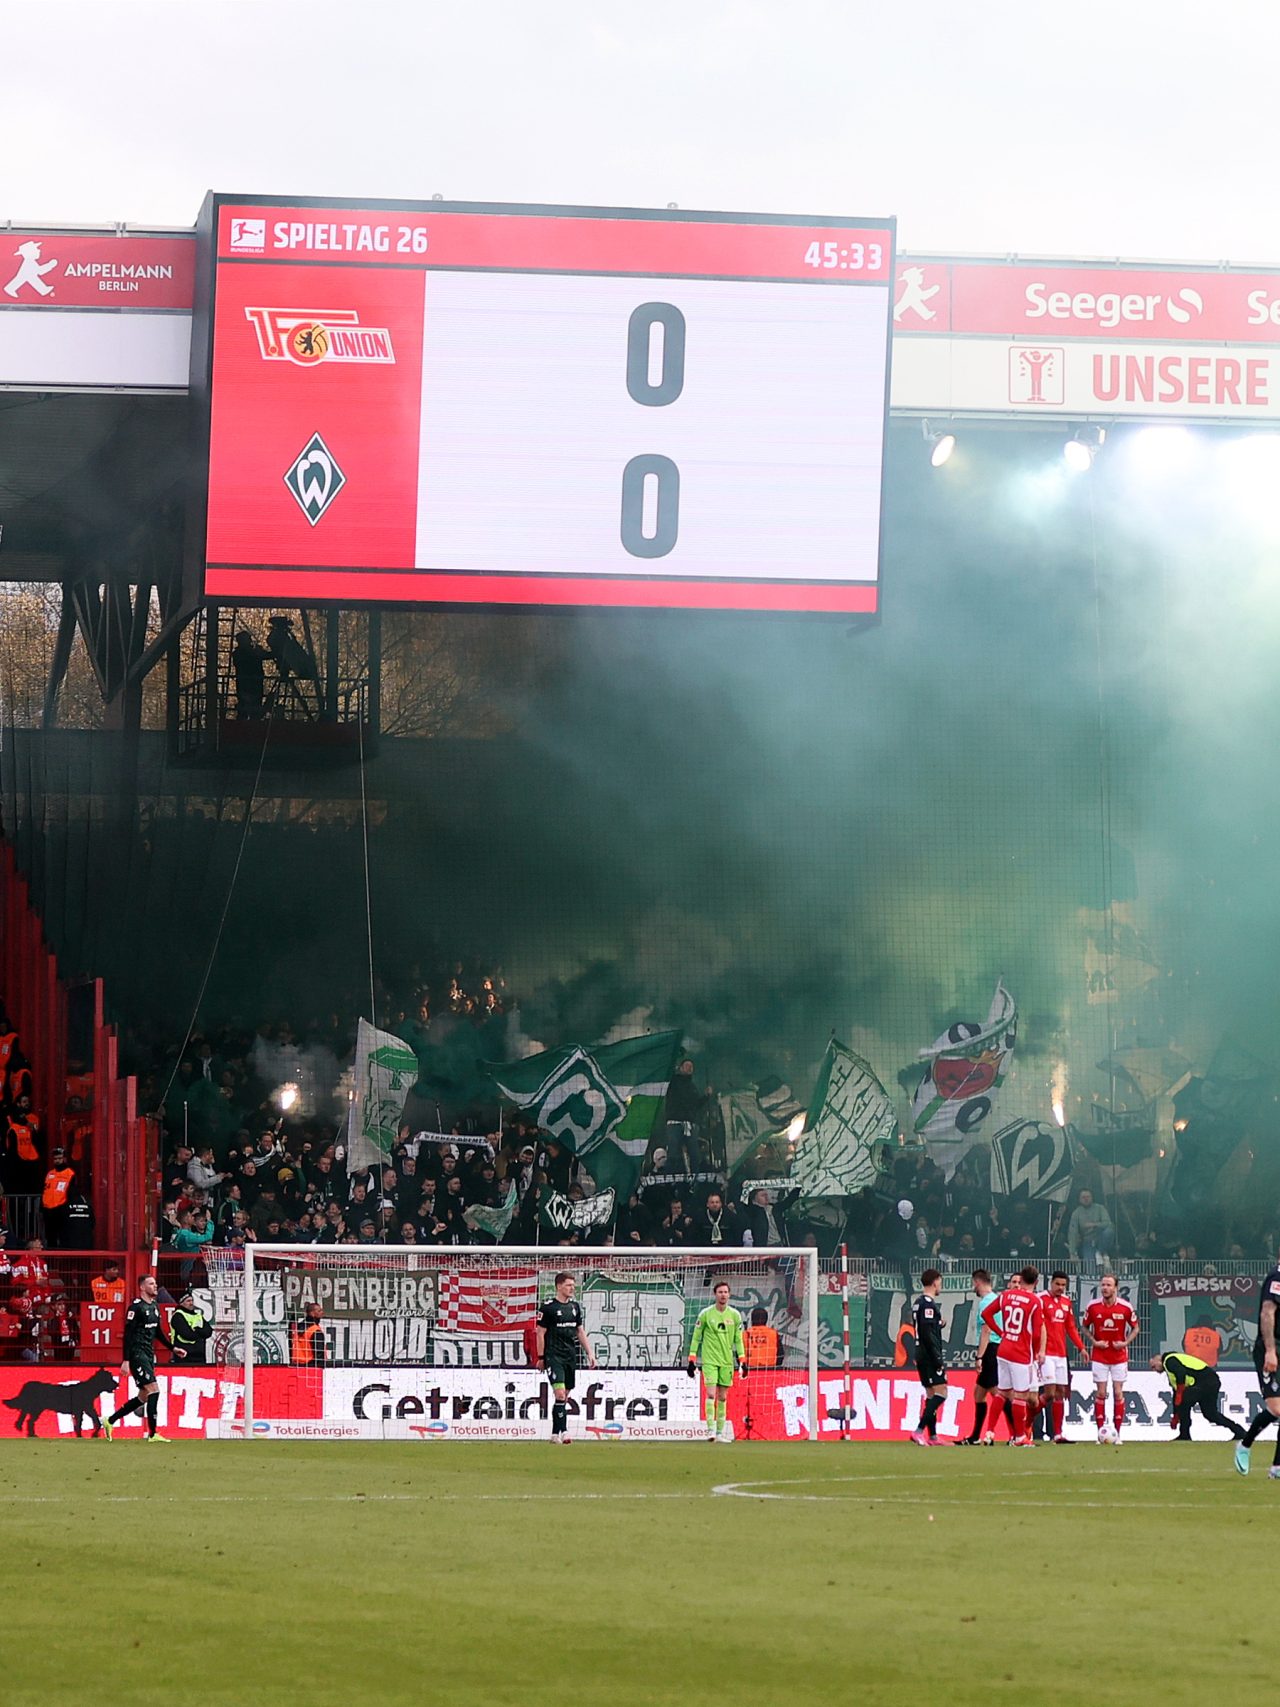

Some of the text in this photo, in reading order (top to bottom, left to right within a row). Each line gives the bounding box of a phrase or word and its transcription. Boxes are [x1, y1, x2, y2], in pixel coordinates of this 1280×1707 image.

[273, 222, 428, 254] SPIELTAG 26
[803, 239, 883, 271] 45:33
[64, 263, 173, 279] AMPELMANN
[99, 281, 139, 291] BERLIN
[1025, 283, 1162, 327] Seeger
[330, 330, 391, 361] UNION
[625, 302, 687, 407] 0
[1092, 355, 1270, 408] UNSERE
[620, 453, 681, 559] 0
[286, 1276, 435, 1311] PAPENBURG
[1174, 1277, 1231, 1293] HERSH
[88, 1305, 115, 1321] Tor
[1005, 1305, 1024, 1335] 29
[91, 1328, 110, 1344] 11
[319, 1318, 428, 1360] ETMOLD
[586, 1331, 682, 1367] CREW
[1192, 1334, 1212, 1345] 210
[353, 1382, 668, 1420] Getreidefrei
[776, 1378, 966, 1437] RINTI
[274, 1425, 360, 1438] TotalEnergies
[452, 1426, 537, 1436] TotalEnergies
[629, 1427, 711, 1437] TotalEnergies
